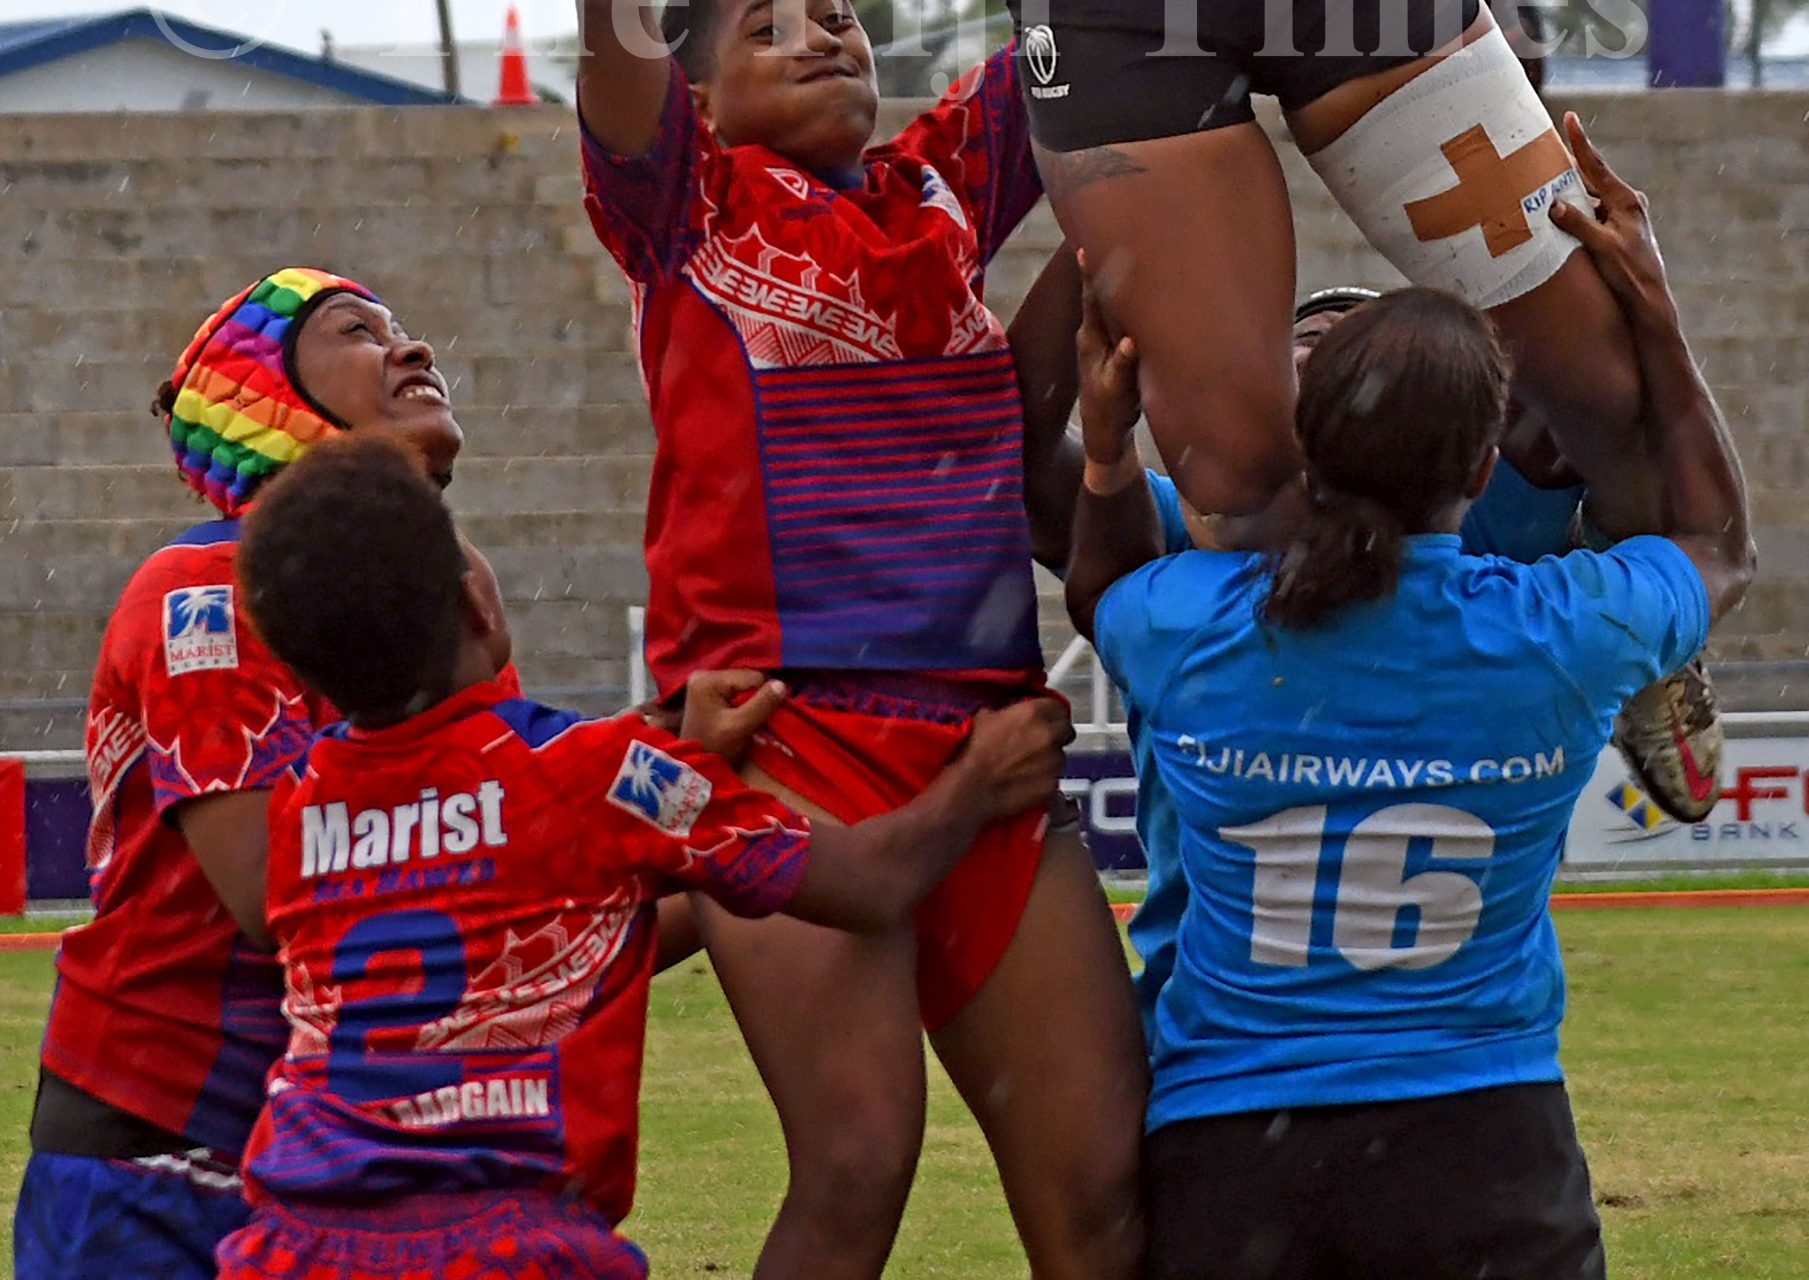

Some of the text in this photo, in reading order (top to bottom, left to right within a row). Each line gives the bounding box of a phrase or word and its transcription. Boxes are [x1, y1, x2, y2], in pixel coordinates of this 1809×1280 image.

[1523, 187, 1547, 214] RIP
[301, 779, 508, 880] Marist
[1691, 822, 1799, 842] BANK
[1219, 802, 1496, 972] 16
[326, 908, 468, 1103] 2
